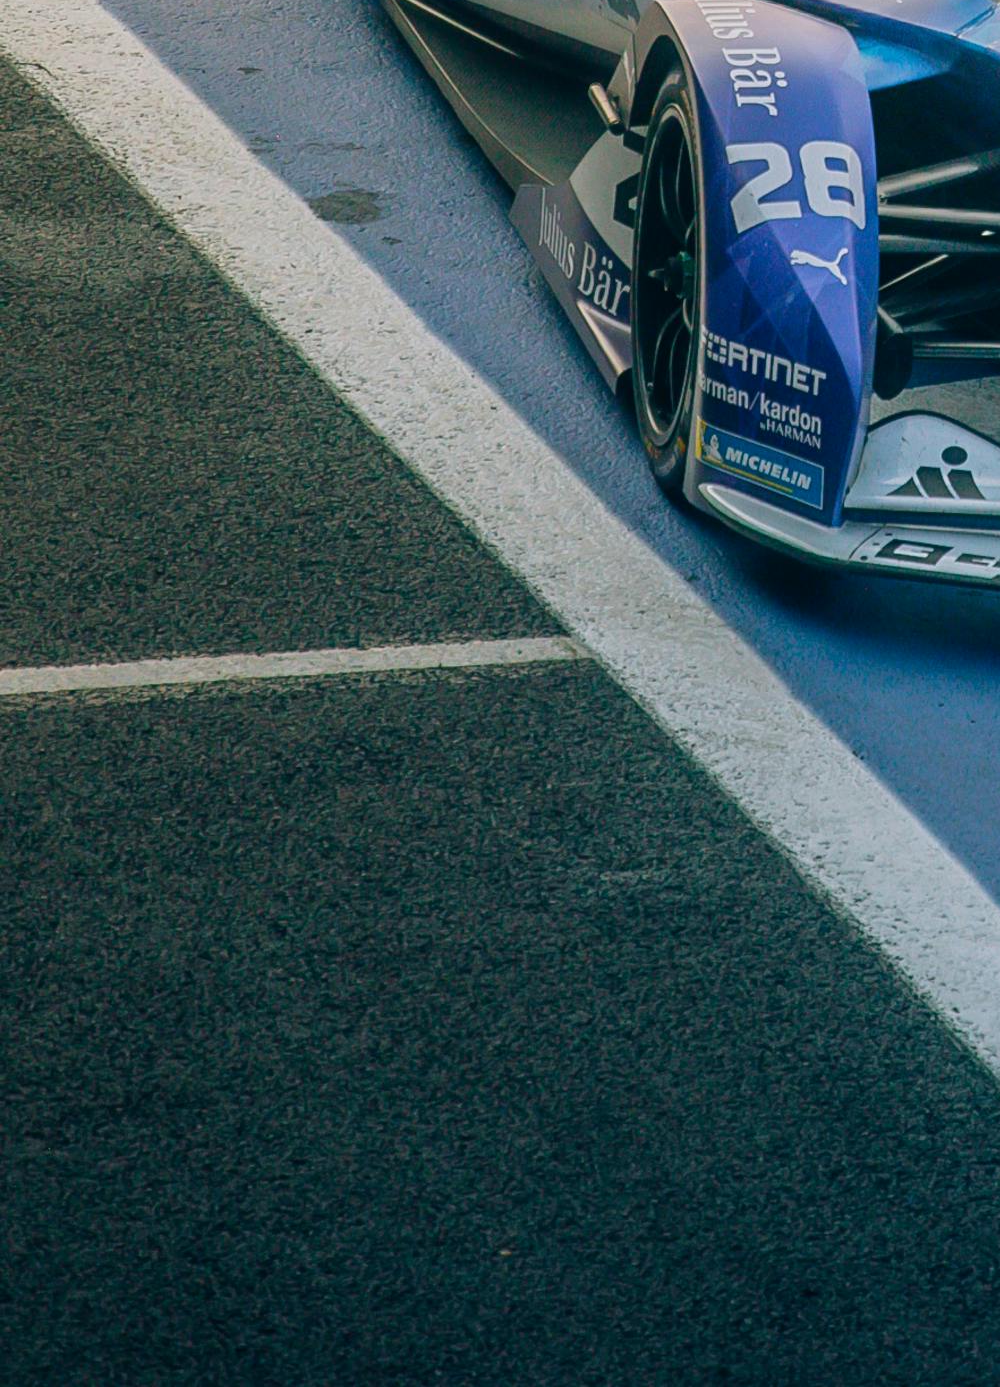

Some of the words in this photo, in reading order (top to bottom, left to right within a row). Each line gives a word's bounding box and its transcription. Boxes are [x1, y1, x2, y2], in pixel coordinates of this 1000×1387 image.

[722, 47, 788, 117] Bär
[725, 140, 866, 234] 28
[538, 187, 576, 280] Julius
[577, 241, 632, 317] Bär
[725, 447, 813, 491] MICHELIN
